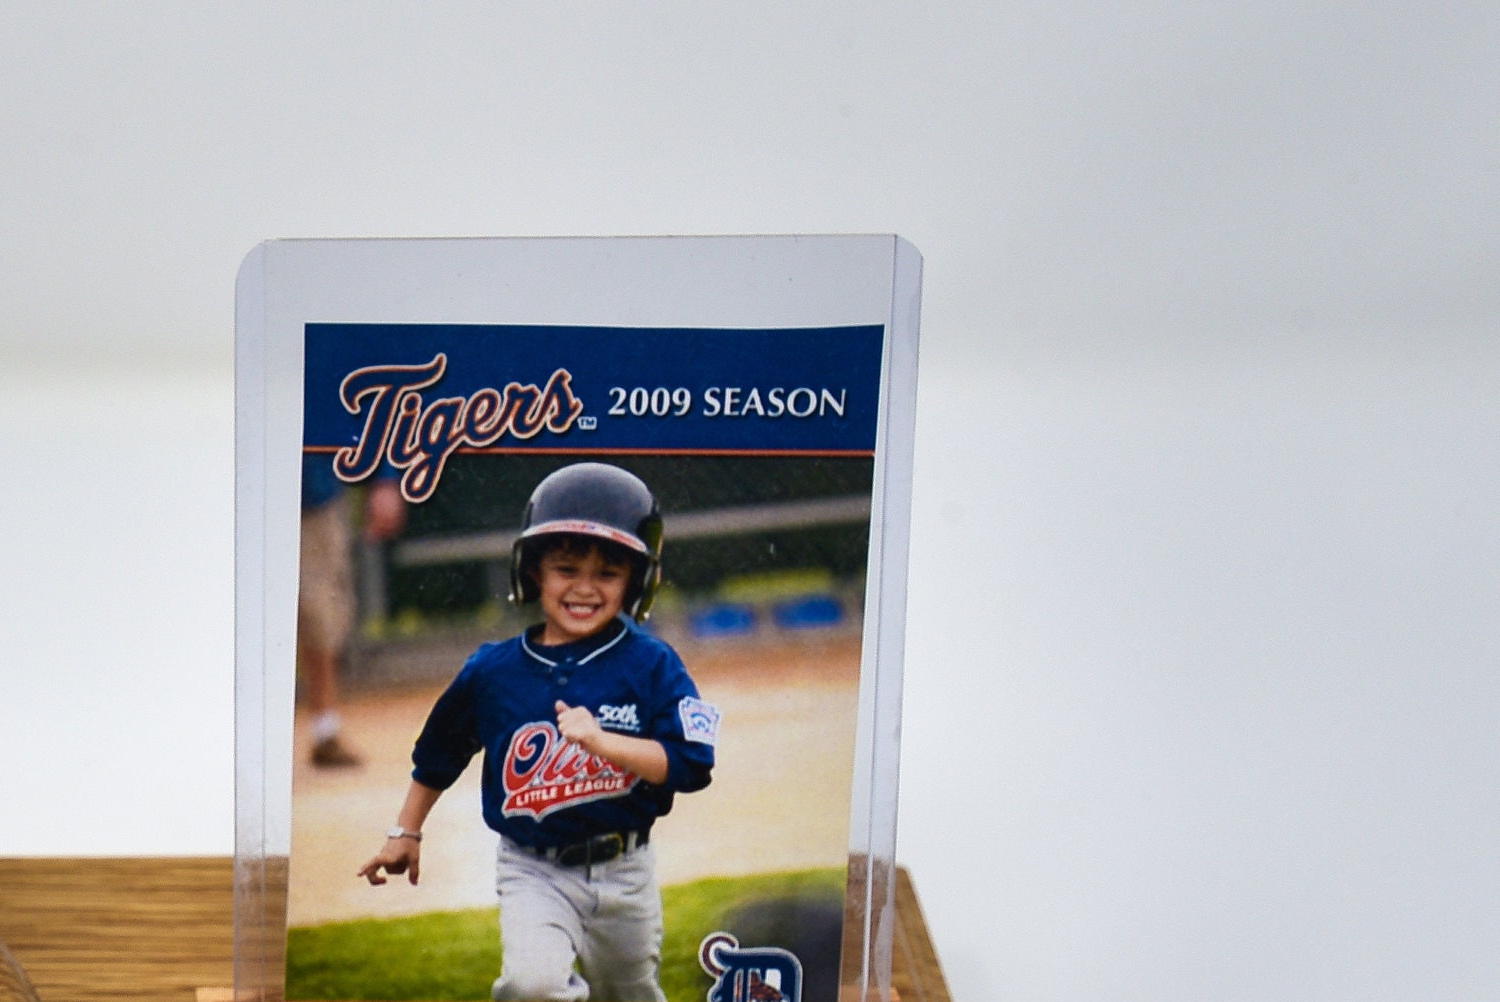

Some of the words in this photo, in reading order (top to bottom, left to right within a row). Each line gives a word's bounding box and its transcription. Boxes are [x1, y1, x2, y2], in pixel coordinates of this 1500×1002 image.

[607, 386, 693, 418] 2009
[703, 387, 847, 418] SEASON
[333, 353, 583, 502] Tigers
[515, 785, 558, 807] LITTLE
[564, 777, 626, 797] LEAGUE
